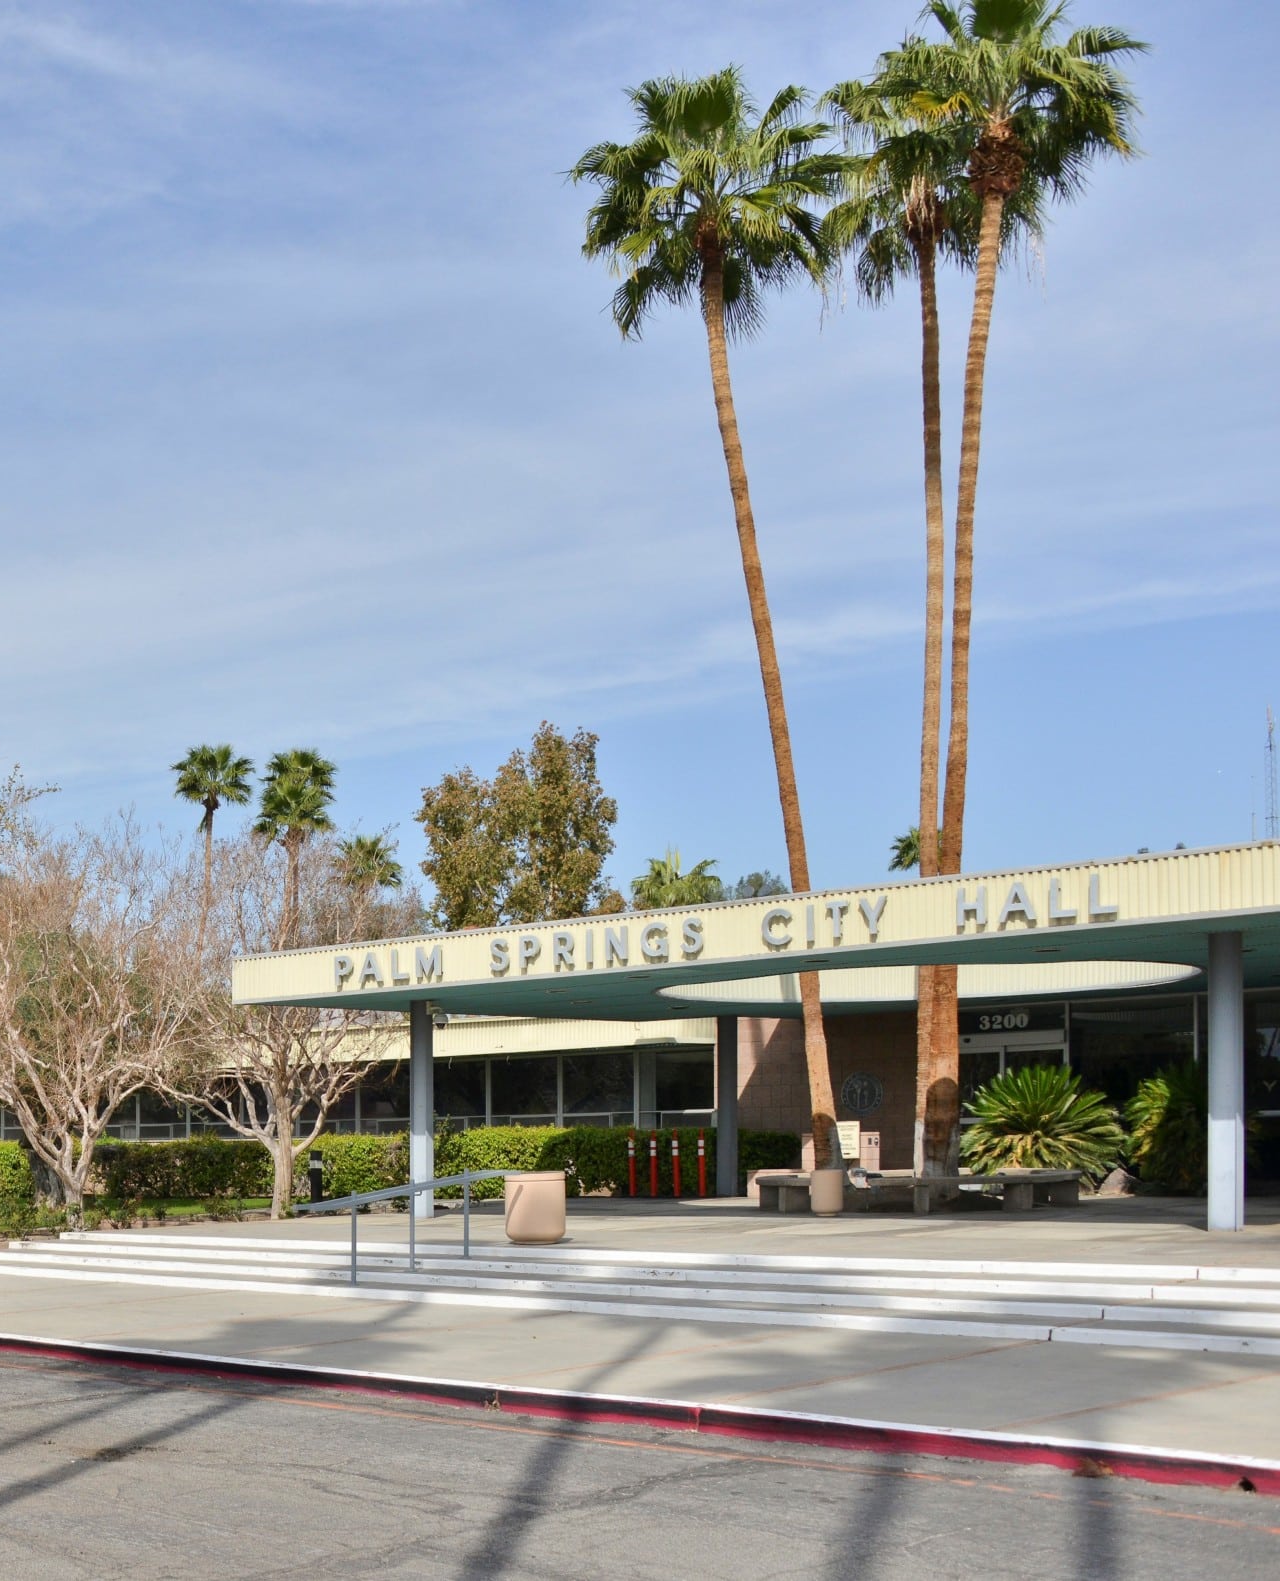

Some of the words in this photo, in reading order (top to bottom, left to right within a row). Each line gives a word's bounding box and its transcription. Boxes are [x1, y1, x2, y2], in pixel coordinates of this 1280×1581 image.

[334, 944, 444, 990] PALM
[489, 918, 705, 975] SPRINGS
[761, 894, 888, 948] CITY
[955, 873, 1119, 931] HALL
[979, 1013, 1029, 1031] 3200
